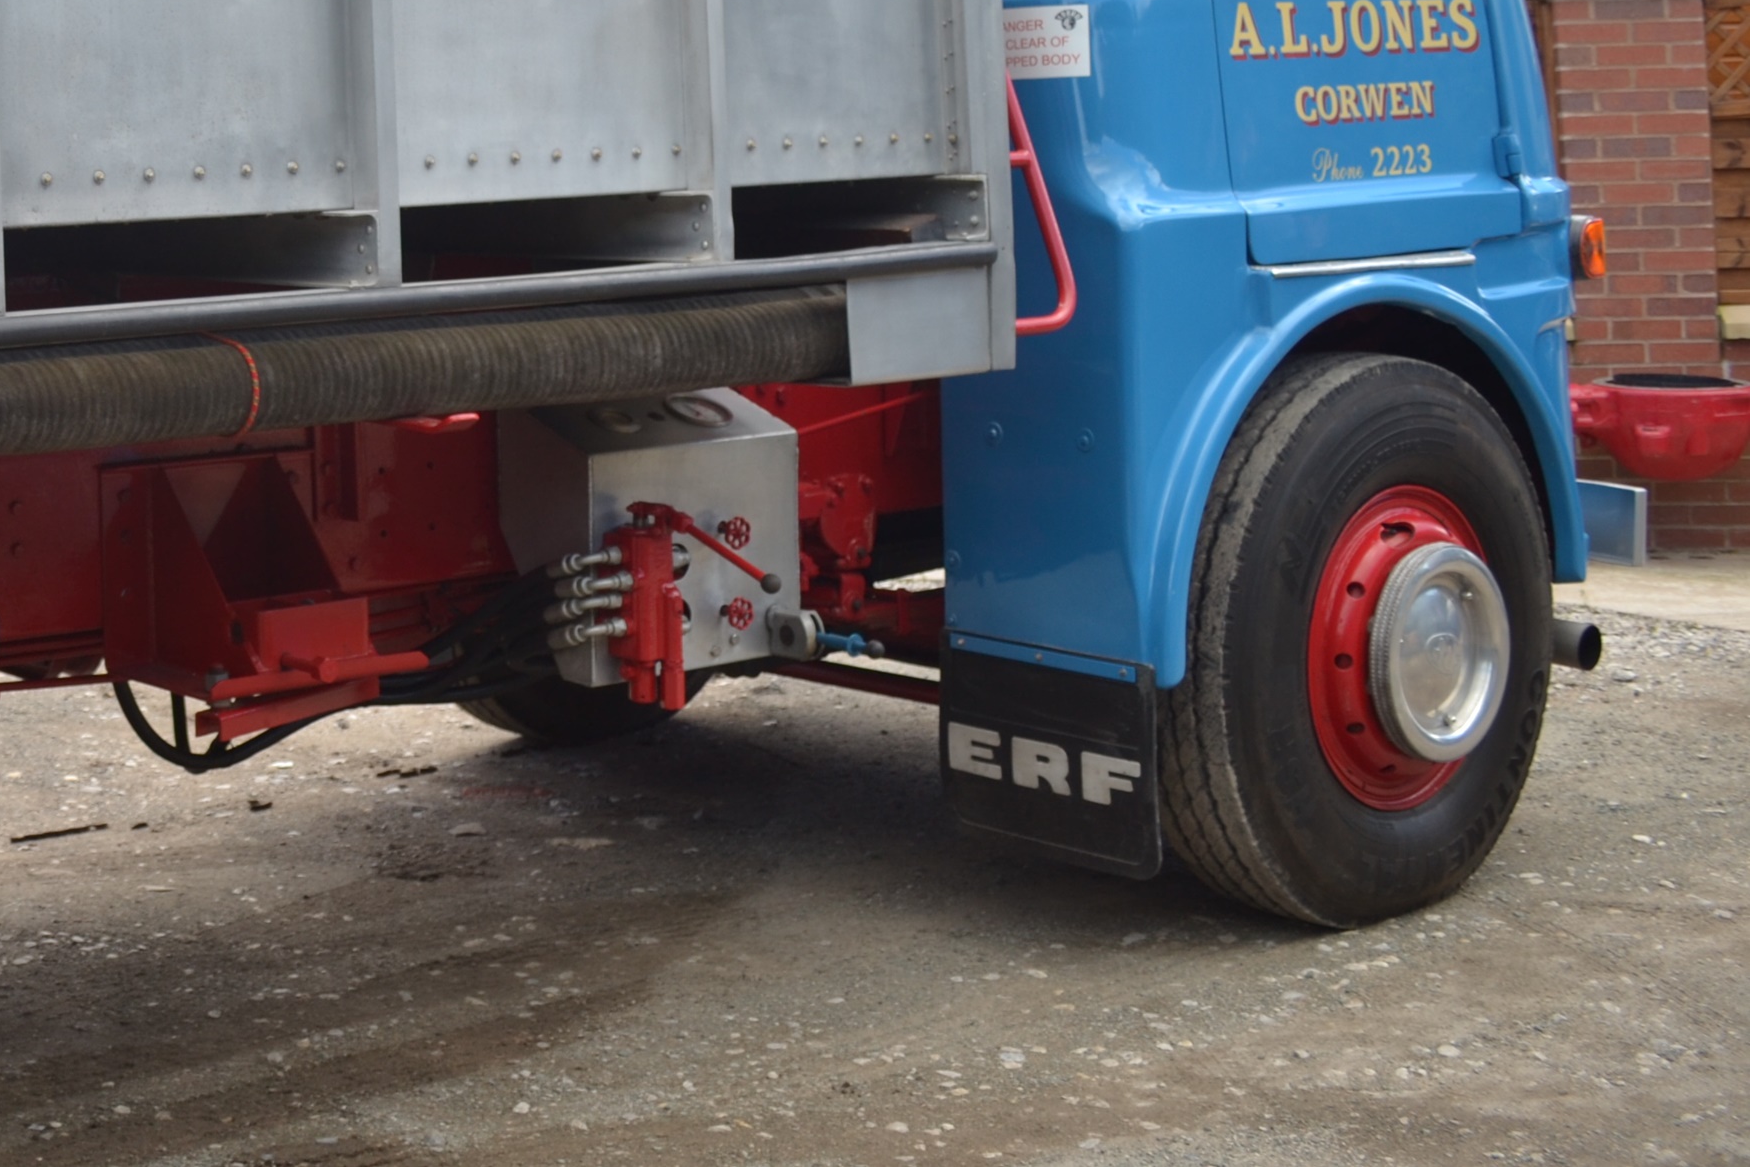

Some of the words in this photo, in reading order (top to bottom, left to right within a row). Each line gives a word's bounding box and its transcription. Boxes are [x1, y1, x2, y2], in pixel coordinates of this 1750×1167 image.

[1005, 37, 1046, 50] CLEAR
[1050, 36, 1070, 48] OF
[1042, 54, 1081, 66] BODY
[1295, 81, 1435, 126] CORWEN
[1312, 147, 1363, 182] Phone
[1371, 144, 1432, 177] 2223
[947, 721, 1141, 806] ERF
